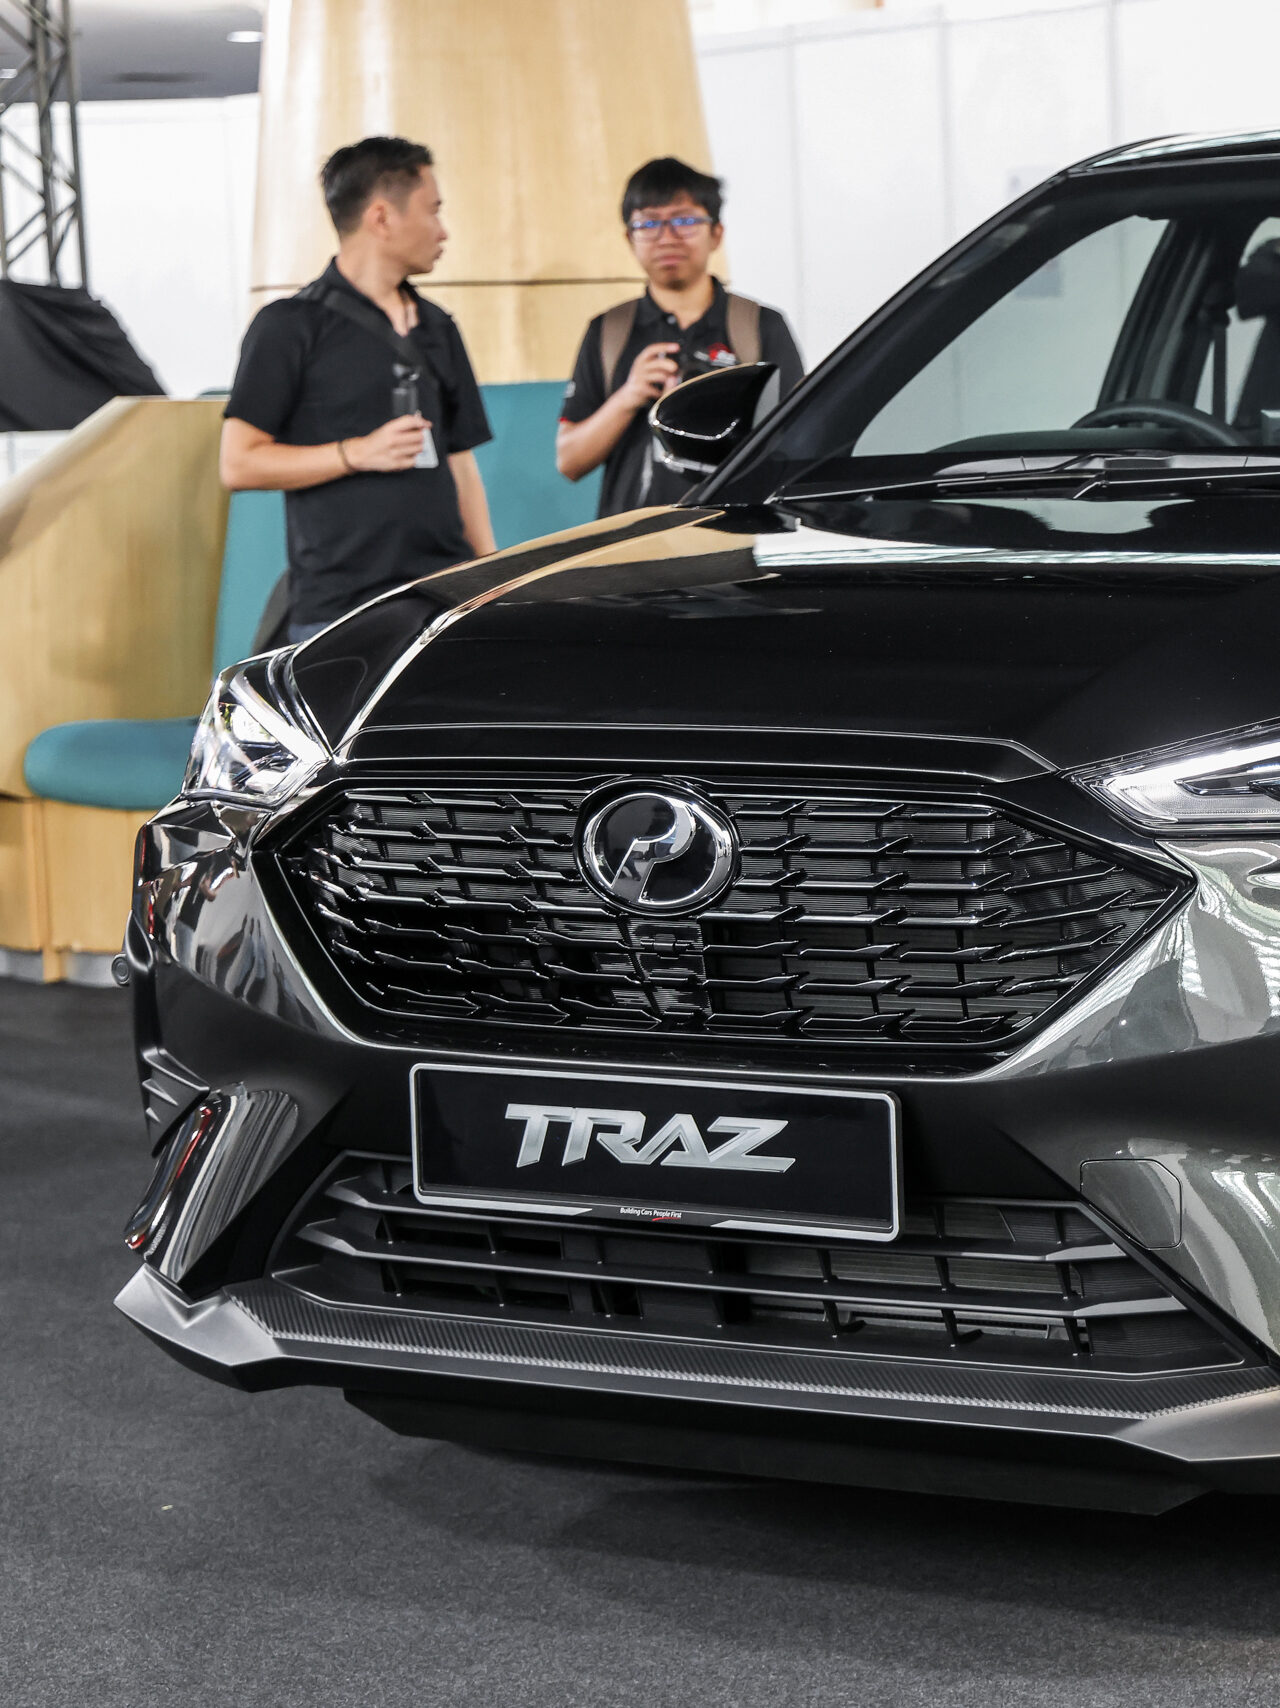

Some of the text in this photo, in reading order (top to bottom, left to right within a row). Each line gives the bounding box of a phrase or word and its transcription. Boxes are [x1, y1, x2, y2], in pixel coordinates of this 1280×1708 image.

[505, 1103, 796, 1173] TRAZ
[620, 1207, 641, 1216] Building
[641, 1208, 653, 1216] Cars
[653, 1210, 671, 1218] People
